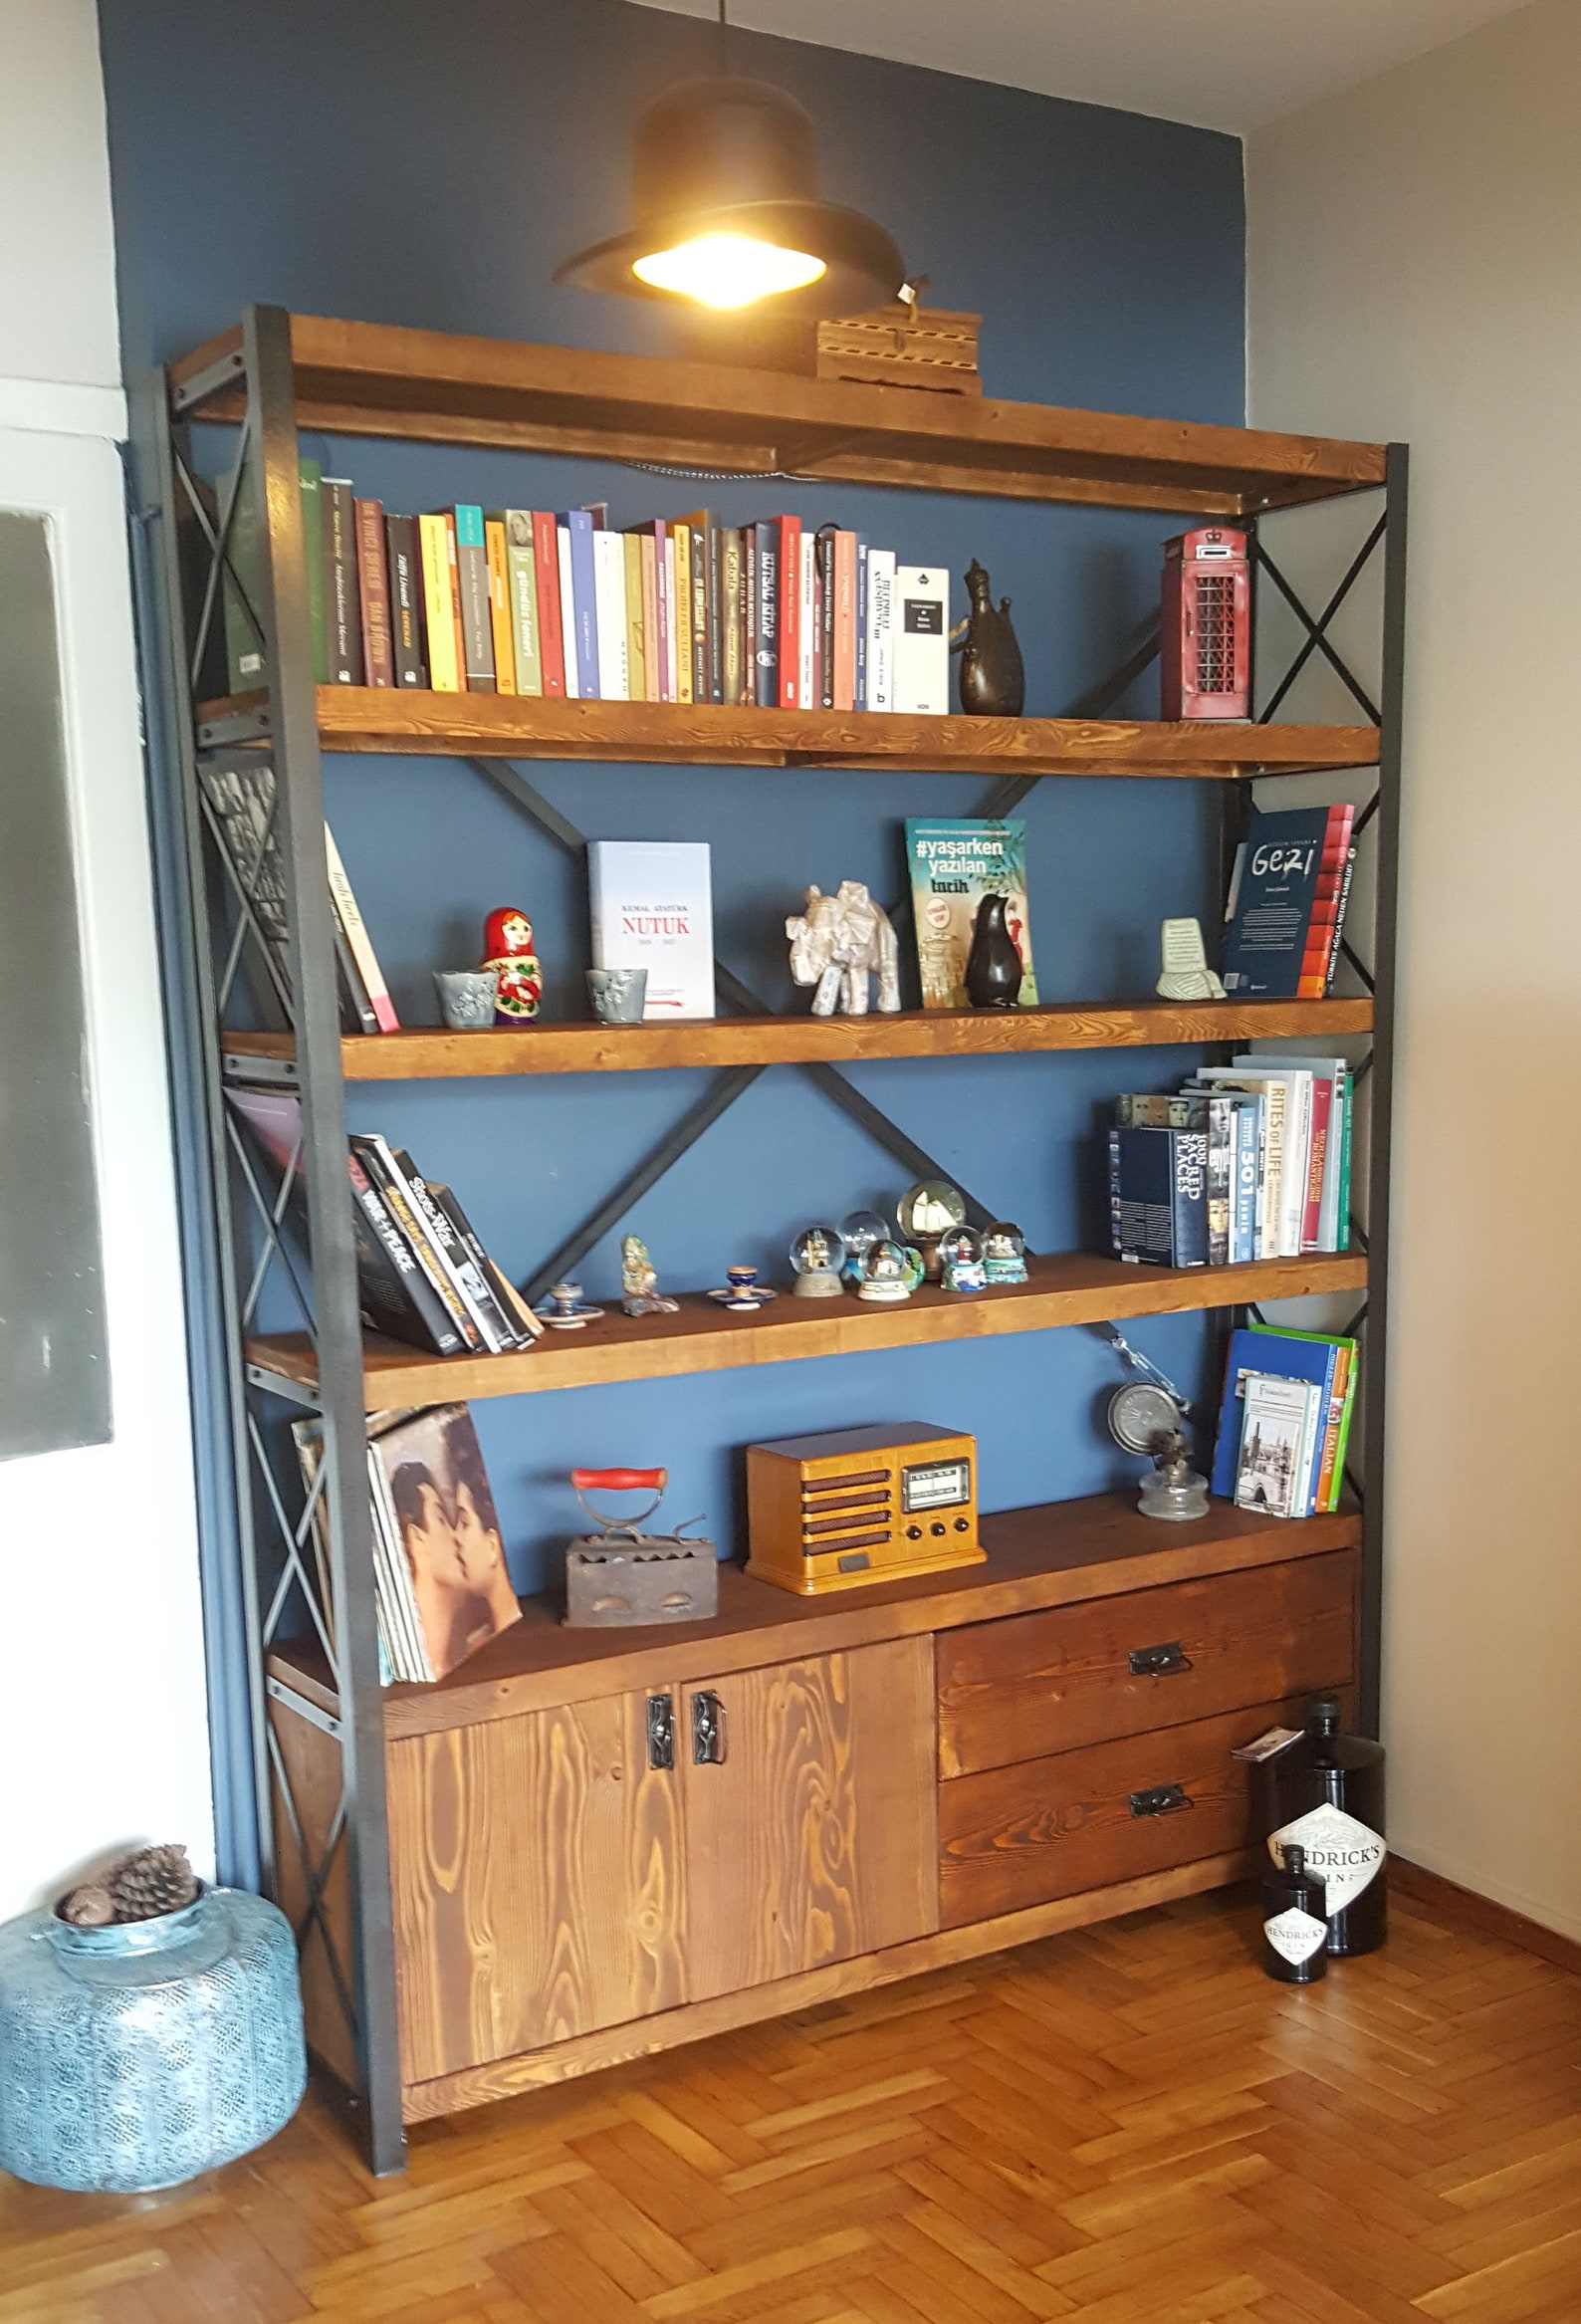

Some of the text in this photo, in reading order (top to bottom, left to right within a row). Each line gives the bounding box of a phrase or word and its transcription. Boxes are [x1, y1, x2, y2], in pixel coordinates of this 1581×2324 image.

[727, 550, 739, 589] Kabala
[516, 571, 532, 617] gündüz
[761, 552, 776, 638] KUTSAL KİTAP
[916, 837, 1004, 858] #yaşarken
[928, 856, 987, 877] yazılan
[931, 878, 970, 893] tarih
[622, 917, 690, 935] NUTUK
[1196, 1133, 1207, 1166] 1000
[1267, 1087, 1285, 1176] RITES OF LIFE
[1177, 1133, 1191, 1194] PLACES
[1187, 1133, 1201, 1200] SACRED
[1241, 1150, 1254, 1195] 501
[1324, 1429, 1337, 1474] ITALIAN
[1274, 1841, 1380, 1866] HDRICK'S
